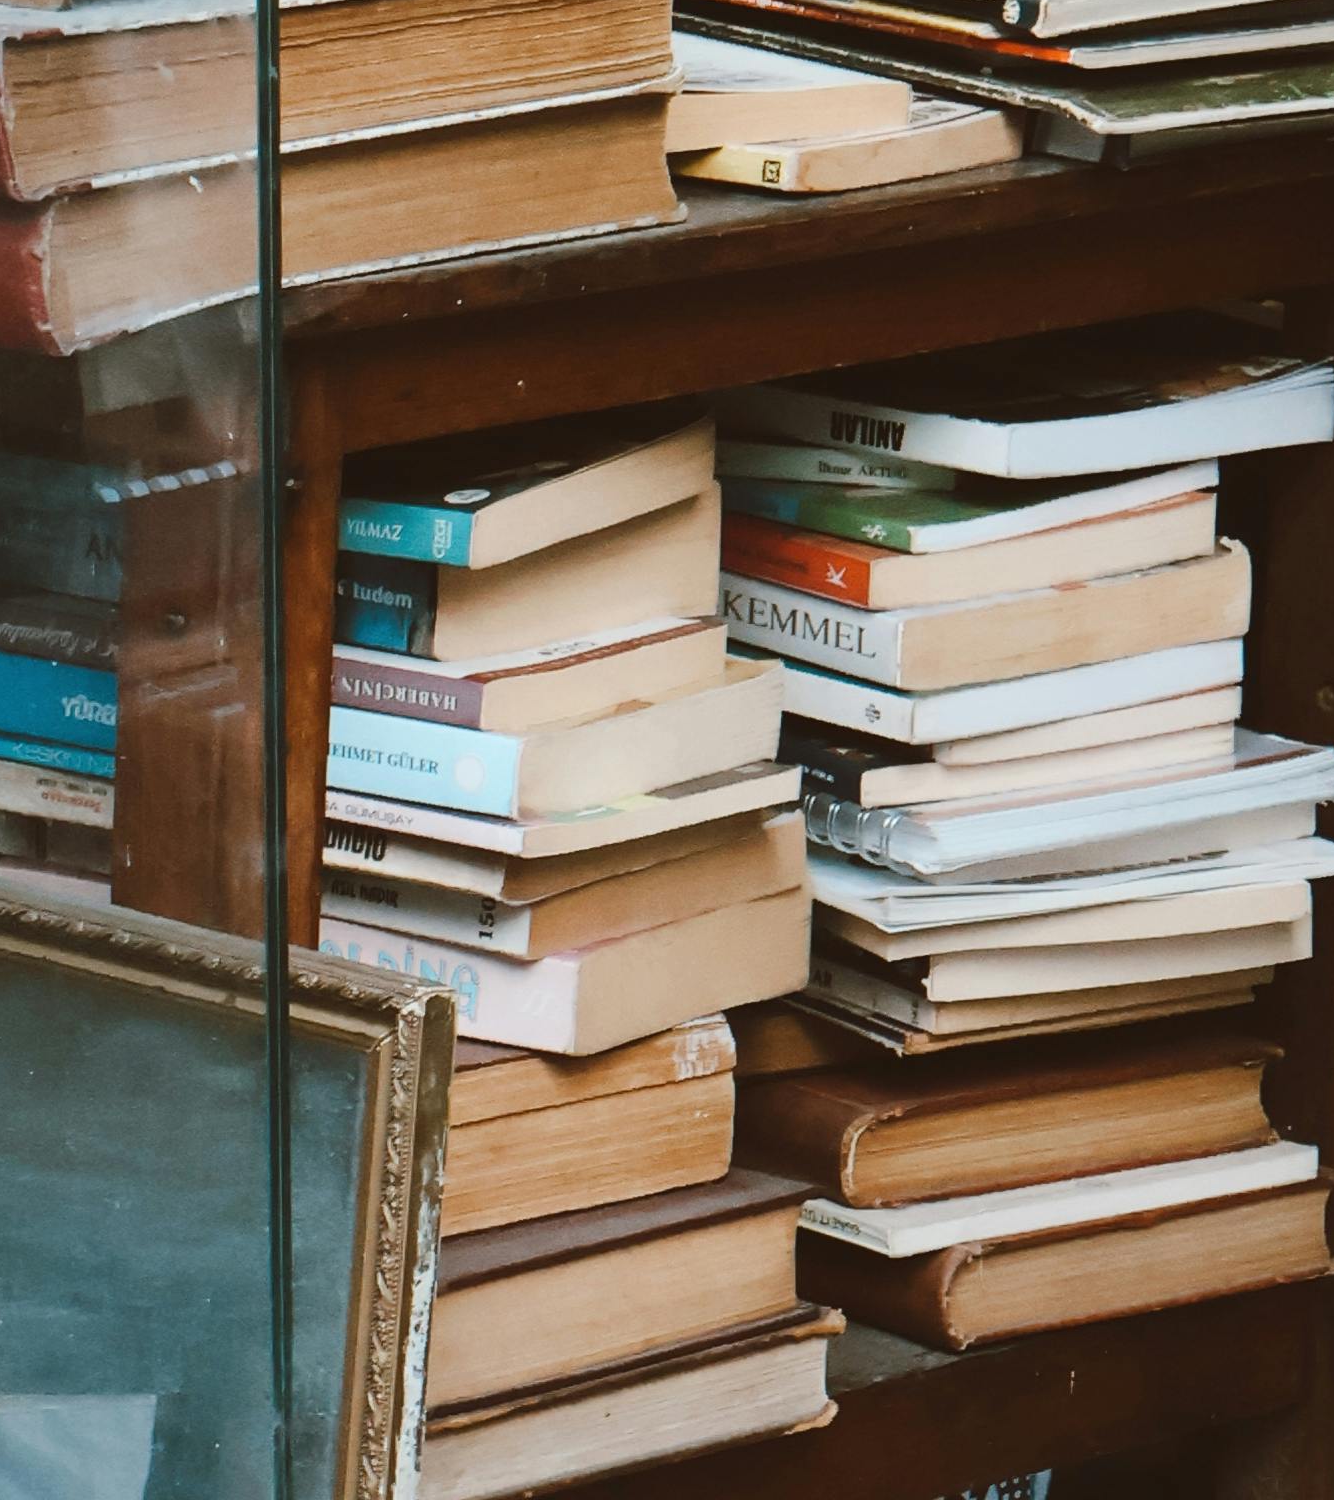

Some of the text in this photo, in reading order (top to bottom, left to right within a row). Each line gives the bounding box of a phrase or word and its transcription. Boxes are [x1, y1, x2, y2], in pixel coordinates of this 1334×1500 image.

[346, 517, 404, 542] YILMAZ
[353, 580, 413, 611] tudem
[722, 589, 877, 658] KEMMEL
[387, 751, 440, 775] GÜLER
